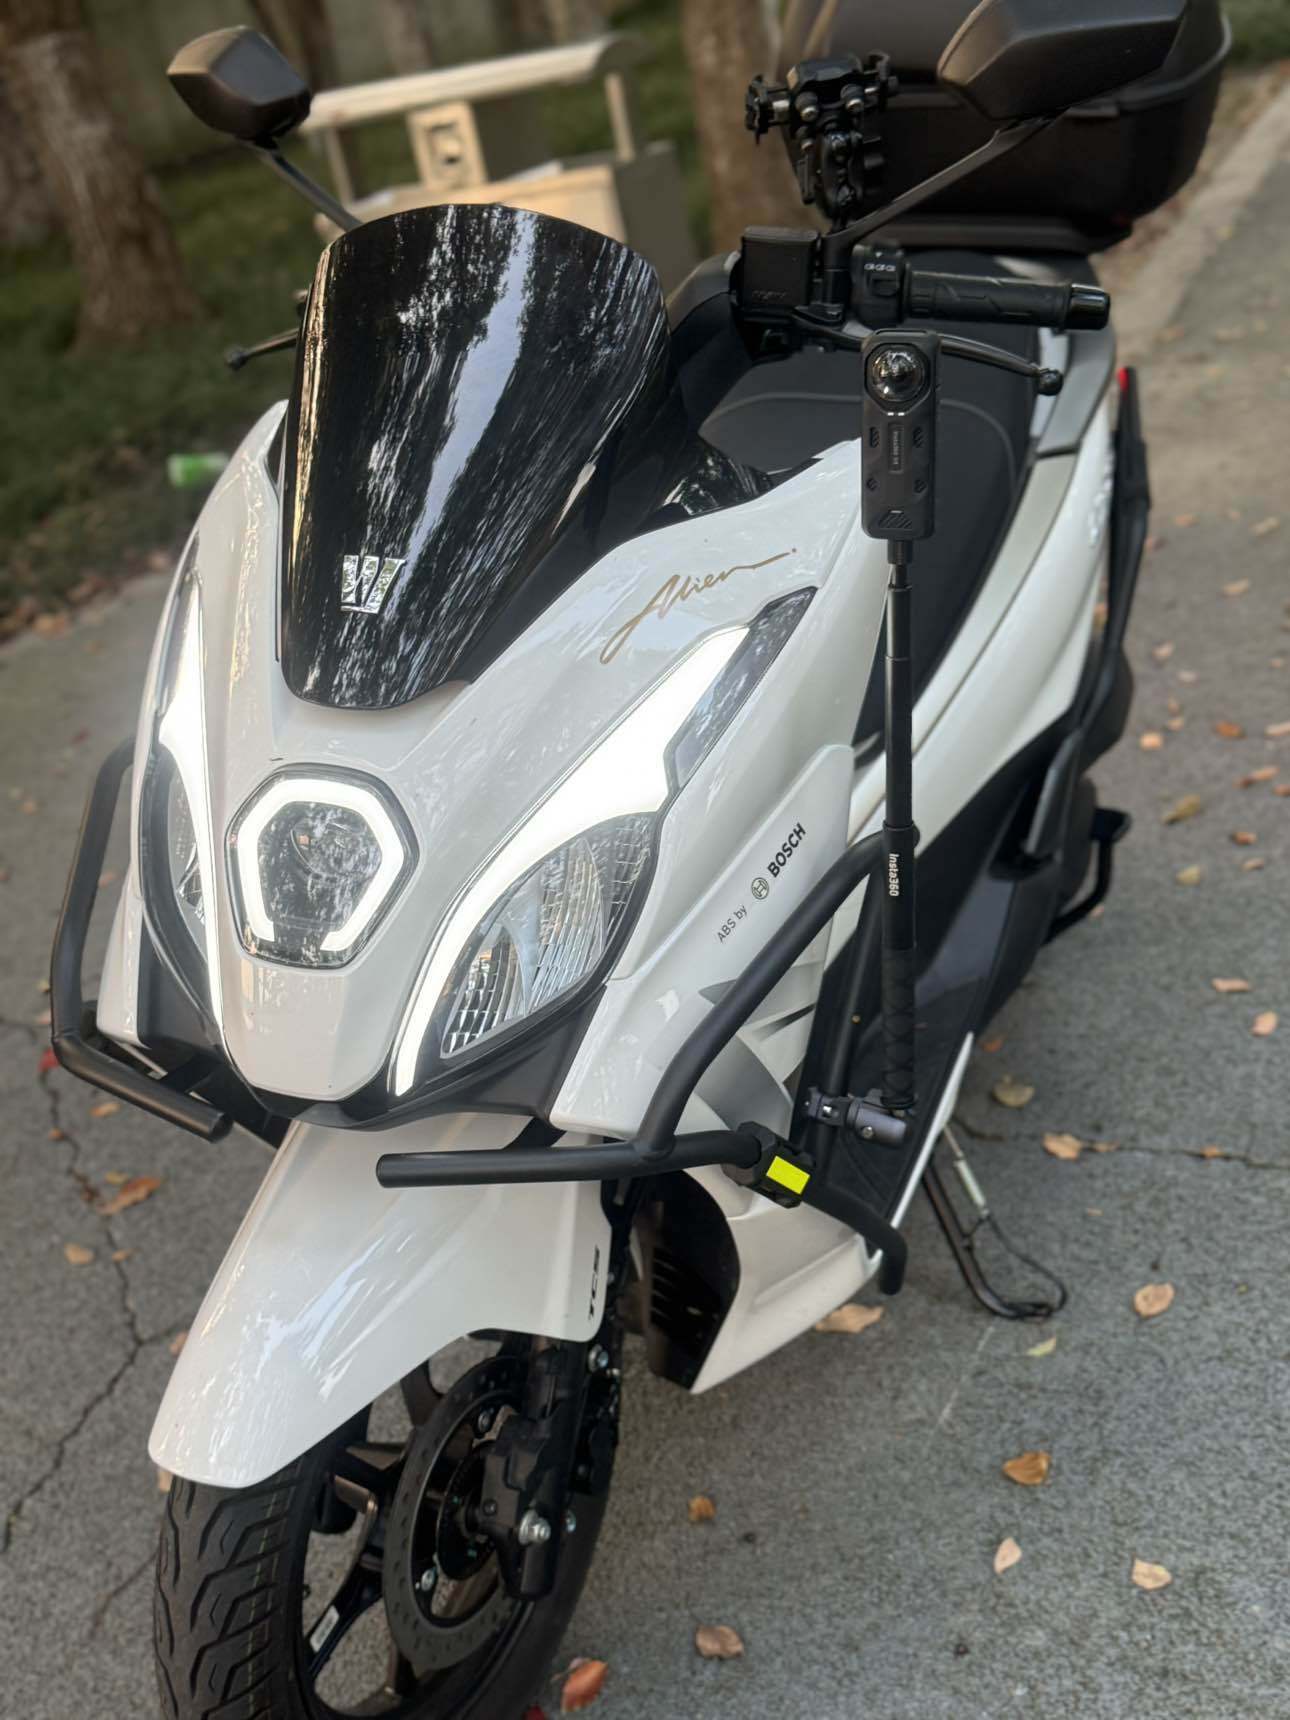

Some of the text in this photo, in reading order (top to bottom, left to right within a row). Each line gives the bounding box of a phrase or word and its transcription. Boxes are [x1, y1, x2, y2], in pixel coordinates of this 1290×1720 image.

[717, 822, 806, 942] ABS by BOSCH
[888, 853, 900, 897] Insta360
